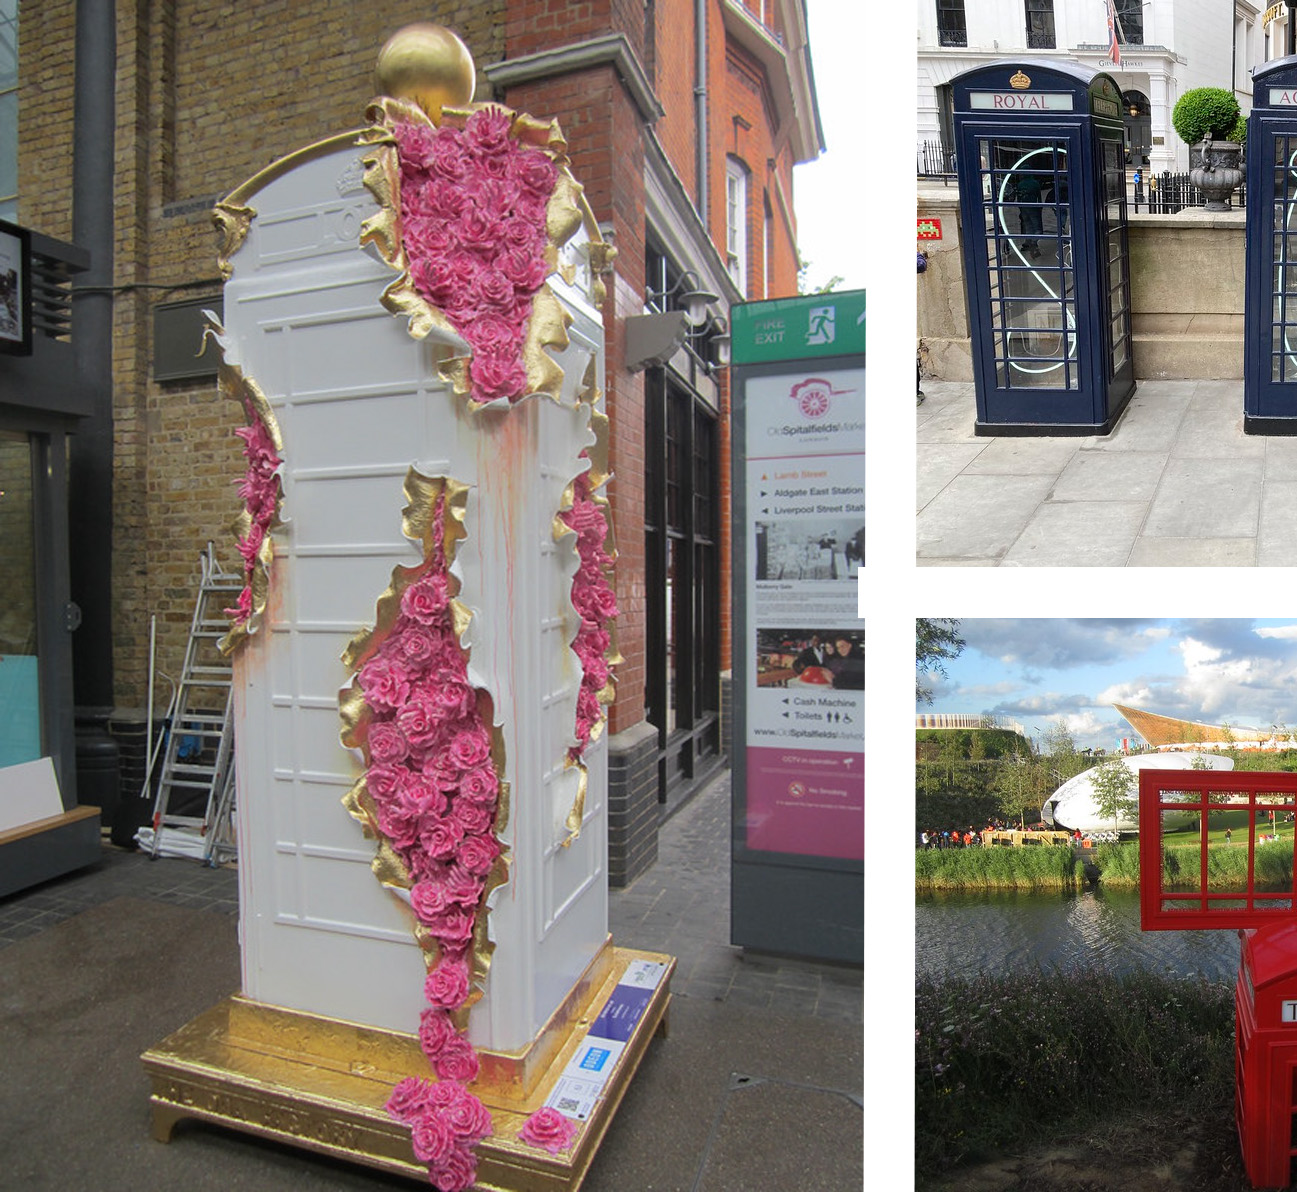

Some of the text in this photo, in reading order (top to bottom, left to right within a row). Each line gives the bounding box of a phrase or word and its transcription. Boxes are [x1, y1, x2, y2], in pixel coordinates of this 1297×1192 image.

[993, 94, 1050, 109] ROYAL
[754, 318, 785, 331] FIRE
[754, 331, 785, 345] EXIT
[774, 470, 828, 480] Lamb Street
[774, 486, 864, 498] Aldgate East Station
[774, 506, 814, 515] Liverpool
[816, 505, 843, 513] Street
[793, 697, 857, 708] Cash Machine
[794, 711, 823, 721] Toilets
